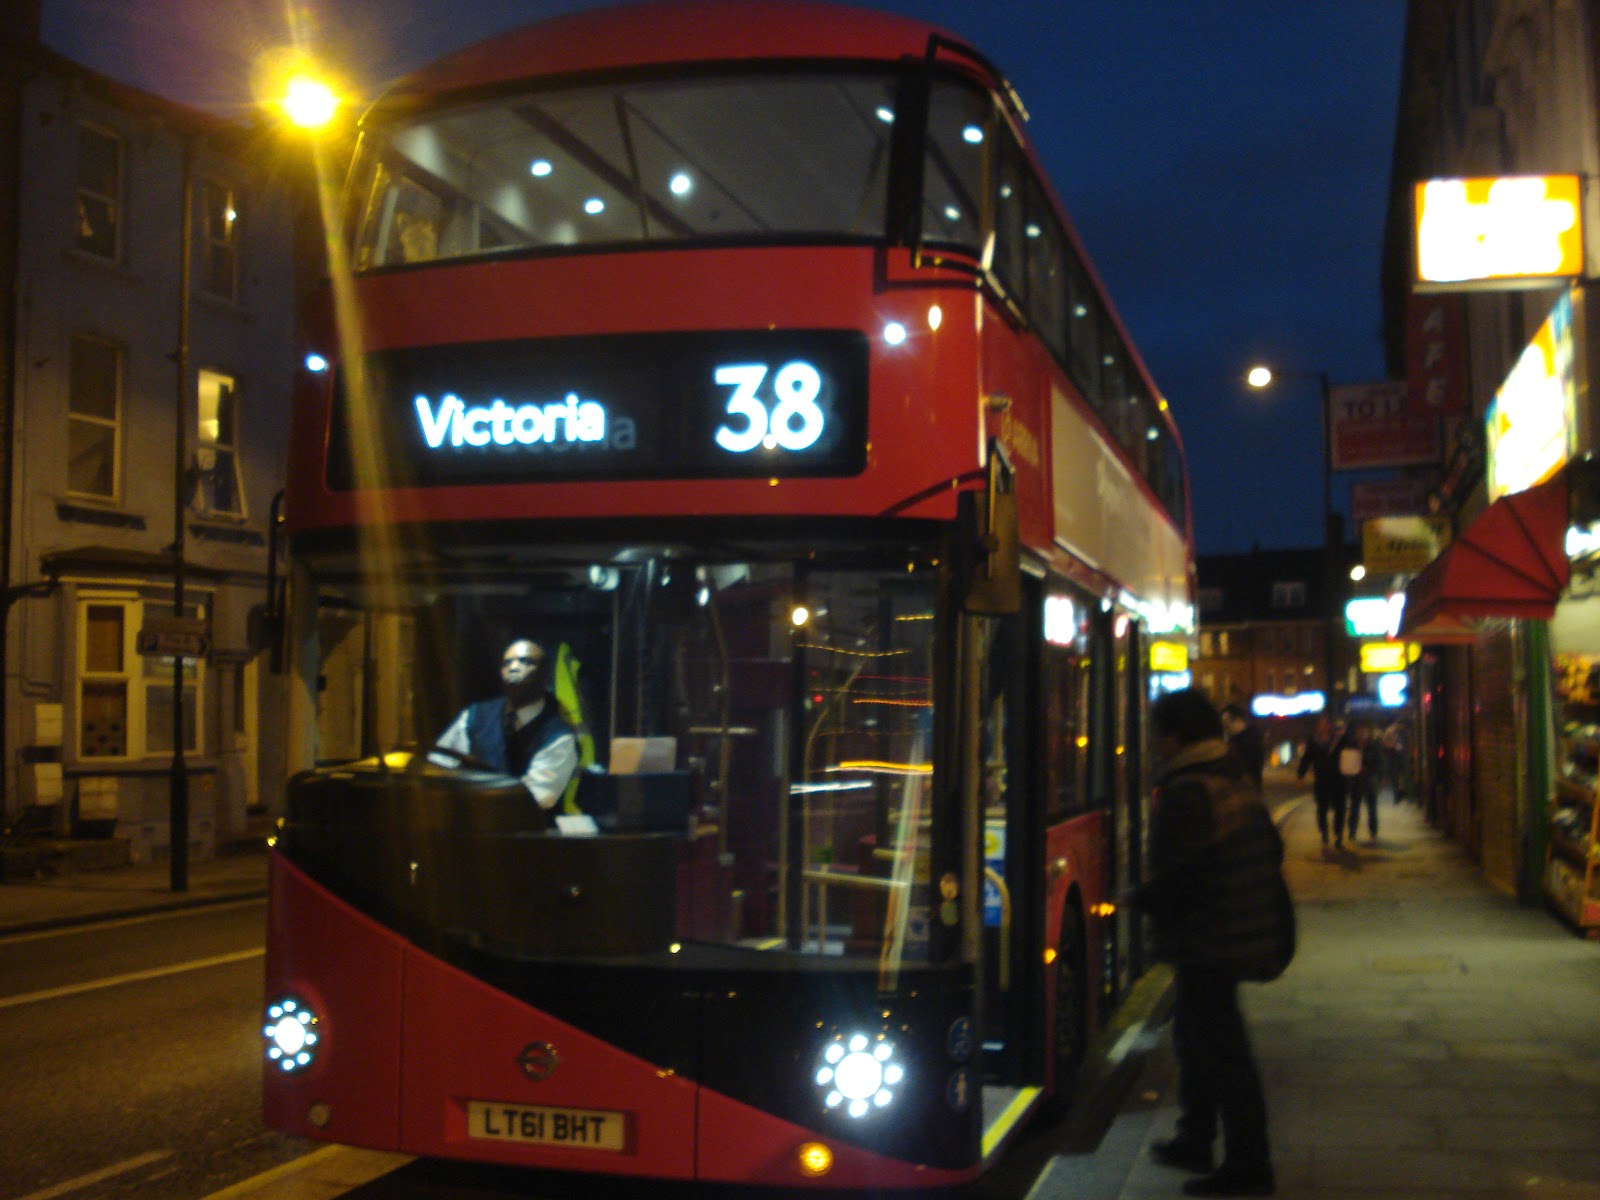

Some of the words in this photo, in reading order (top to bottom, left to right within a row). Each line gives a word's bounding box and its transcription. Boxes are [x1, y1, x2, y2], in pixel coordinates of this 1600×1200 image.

[415, 392, 605, 448] Victoria
[713, 361, 825, 453] 38
[484, 1107, 545, 1139] LT61
[552, 1113, 606, 1144] BHT
